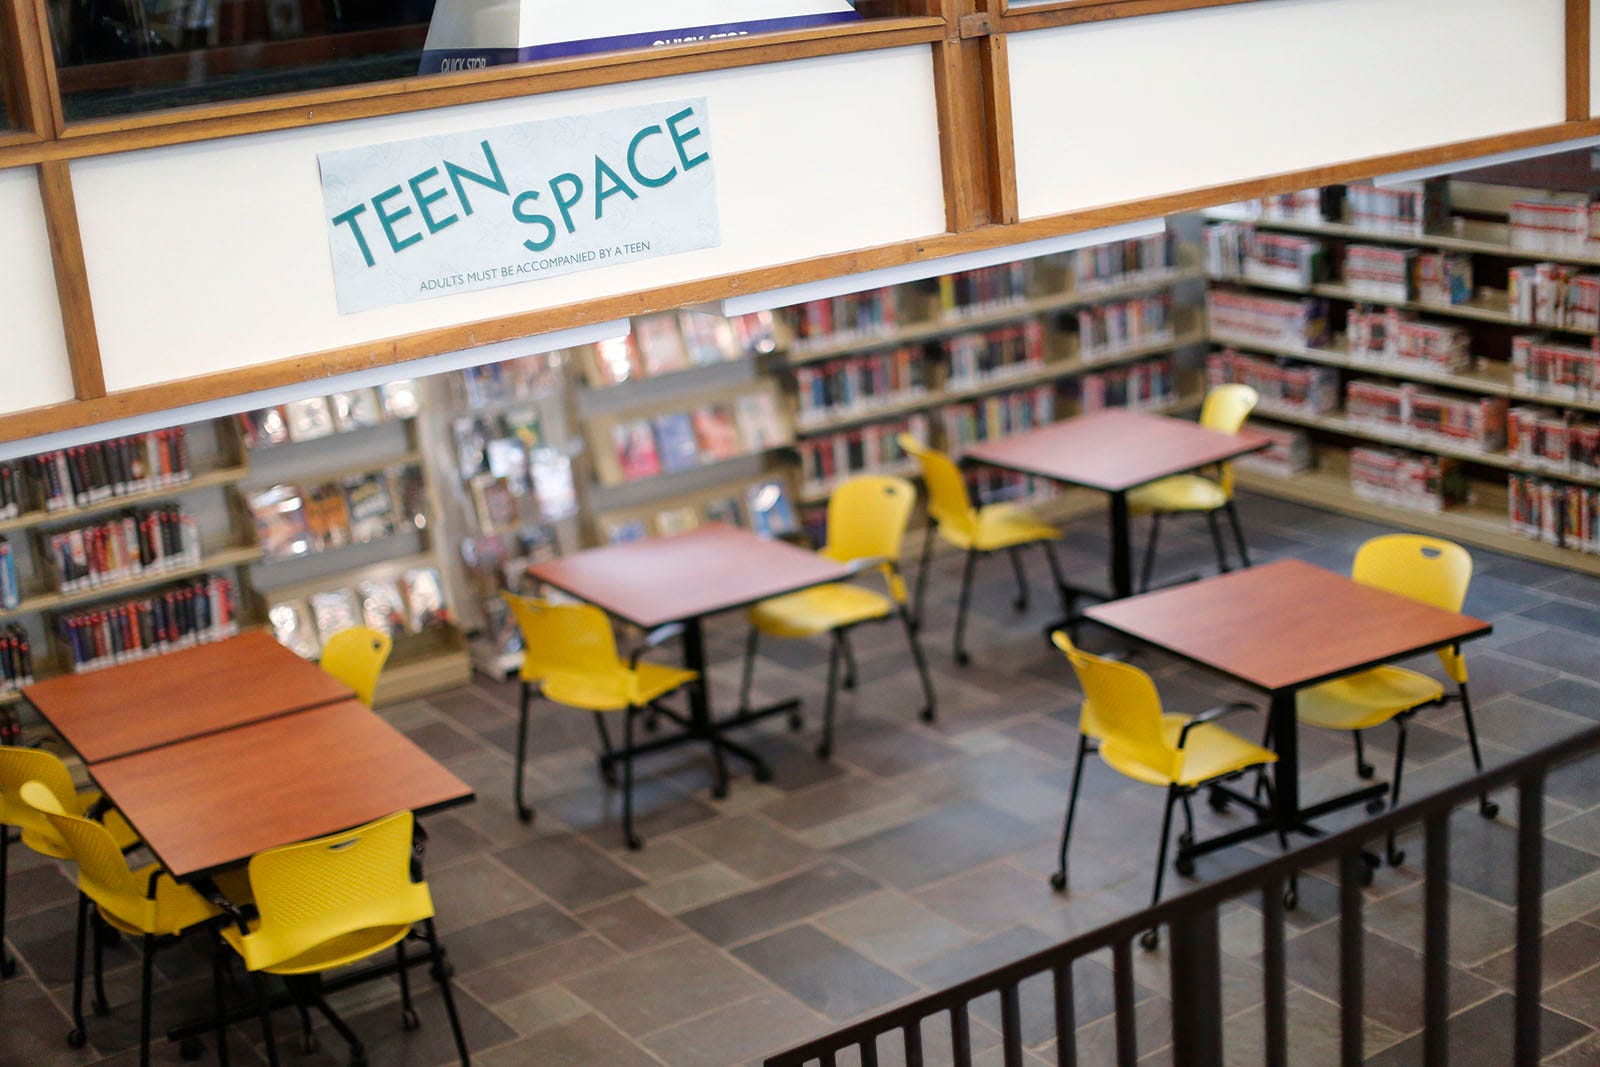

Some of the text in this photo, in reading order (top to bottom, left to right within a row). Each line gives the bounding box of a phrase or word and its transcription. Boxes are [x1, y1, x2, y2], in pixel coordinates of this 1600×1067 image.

[441, 57, 487, 73] QUICK STOP
[332, 140, 509, 268] TEEN
[511, 106, 711, 252] SPACE
[419, 240, 651, 292] ADULTS MUST BE ACCOMPANIED BY A TEEN
